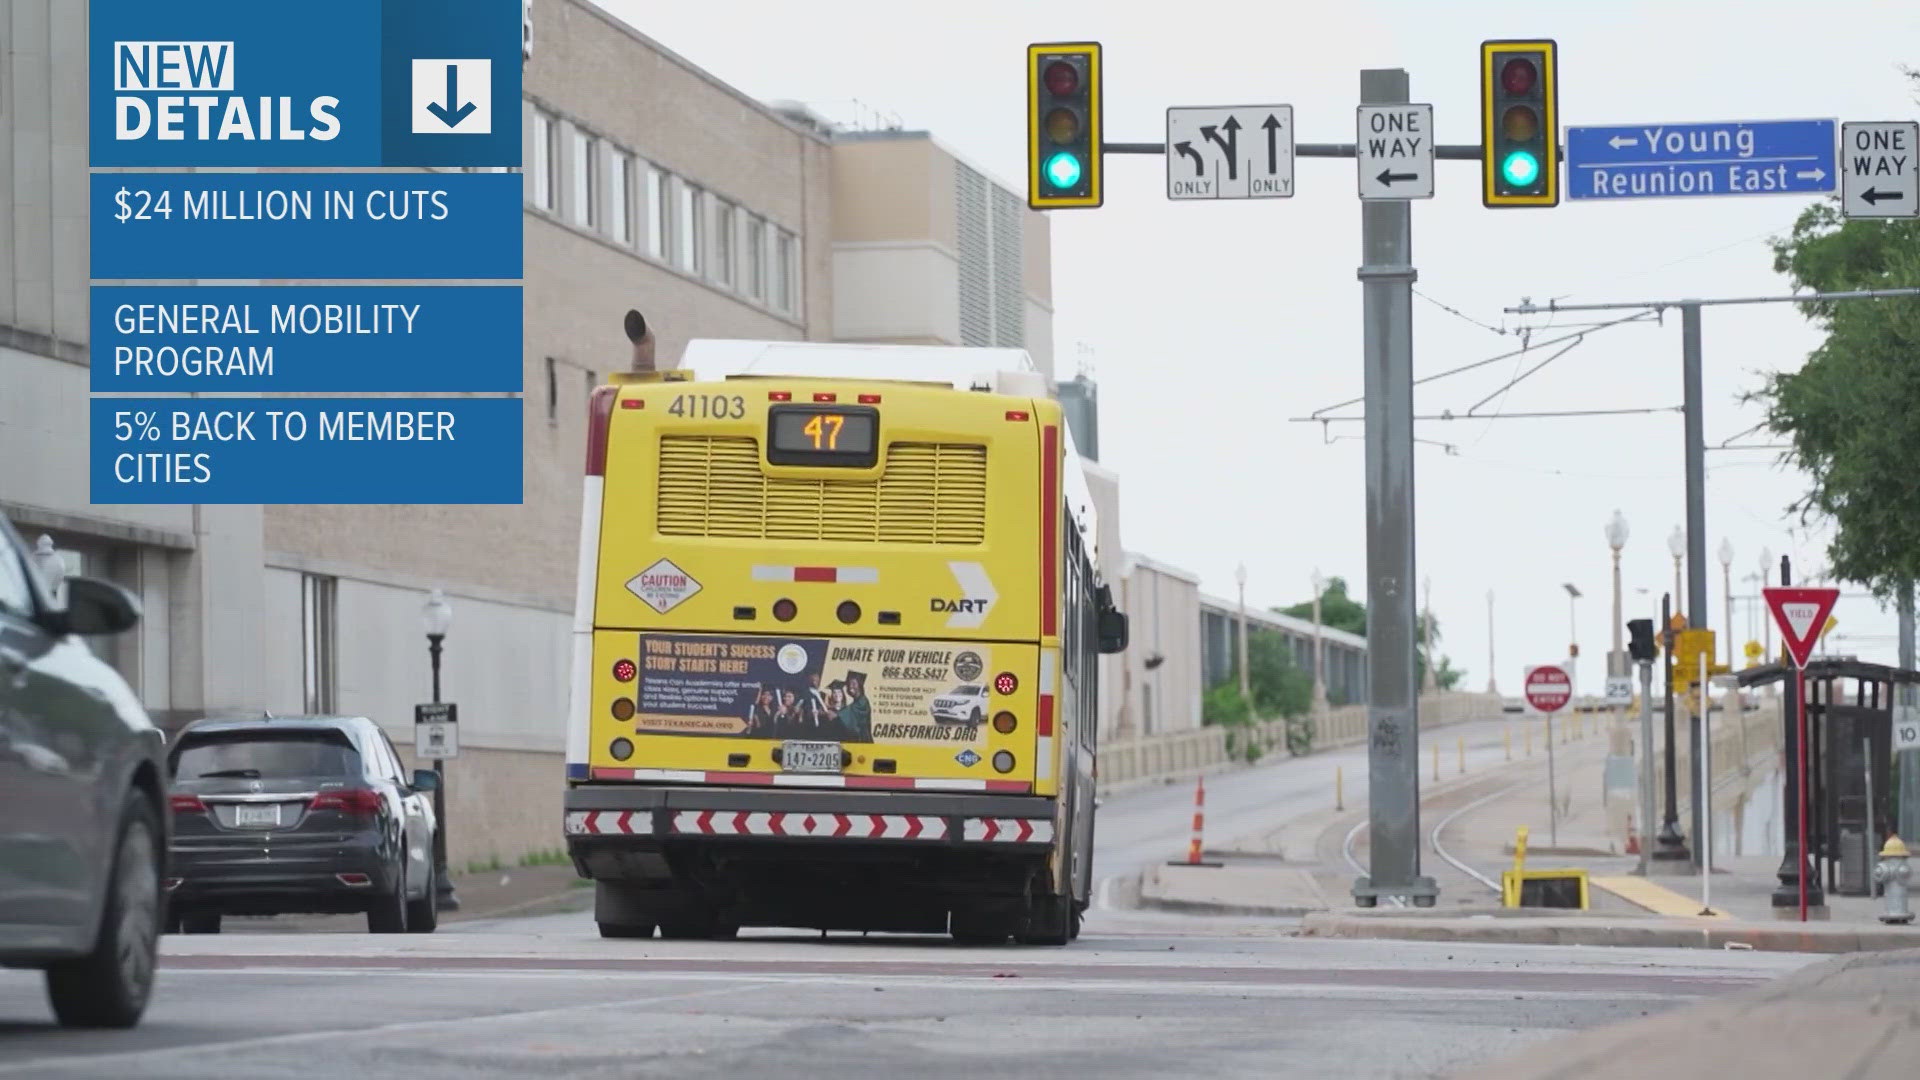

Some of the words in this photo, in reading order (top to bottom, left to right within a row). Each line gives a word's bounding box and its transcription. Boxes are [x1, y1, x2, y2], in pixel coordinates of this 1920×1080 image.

[1370, 111, 1420, 134] ONE
[1368, 137, 1422, 158] WAY
[1643, 127, 1756, 158] Young
[1856, 130, 1906, 151] ONE
[1853, 155, 1907, 176] WAY
[1173, 180, 1212, 196] ONLY
[1252, 178, 1290, 194] ONLY
[1593, 166, 1714, 195] Reunion
[1728, 165, 1788, 191] East
[668, 394, 746, 420] 41103
[803, 415, 845, 450] 47
[641, 574, 687, 587] CAUTION
[930, 598, 988, 613] DART
[1789, 609, 1814, 619] YIELD
[645, 639, 672, 655] YOUR
[674, 641, 728, 658] STUDENT'S
[730, 643, 776, 659] SUCCESS
[831, 647, 875, 662] DONATE
[876, 649, 906, 663] YOUR
[908, 650, 952, 666] VEHICLE
[645, 656, 677, 671] STORY
[678, 658, 718, 672] STARTS
[718, 659, 748, 674] HERE!
[1607, 683, 1629, 697] 25
[1899, 726, 1917, 742] 10
